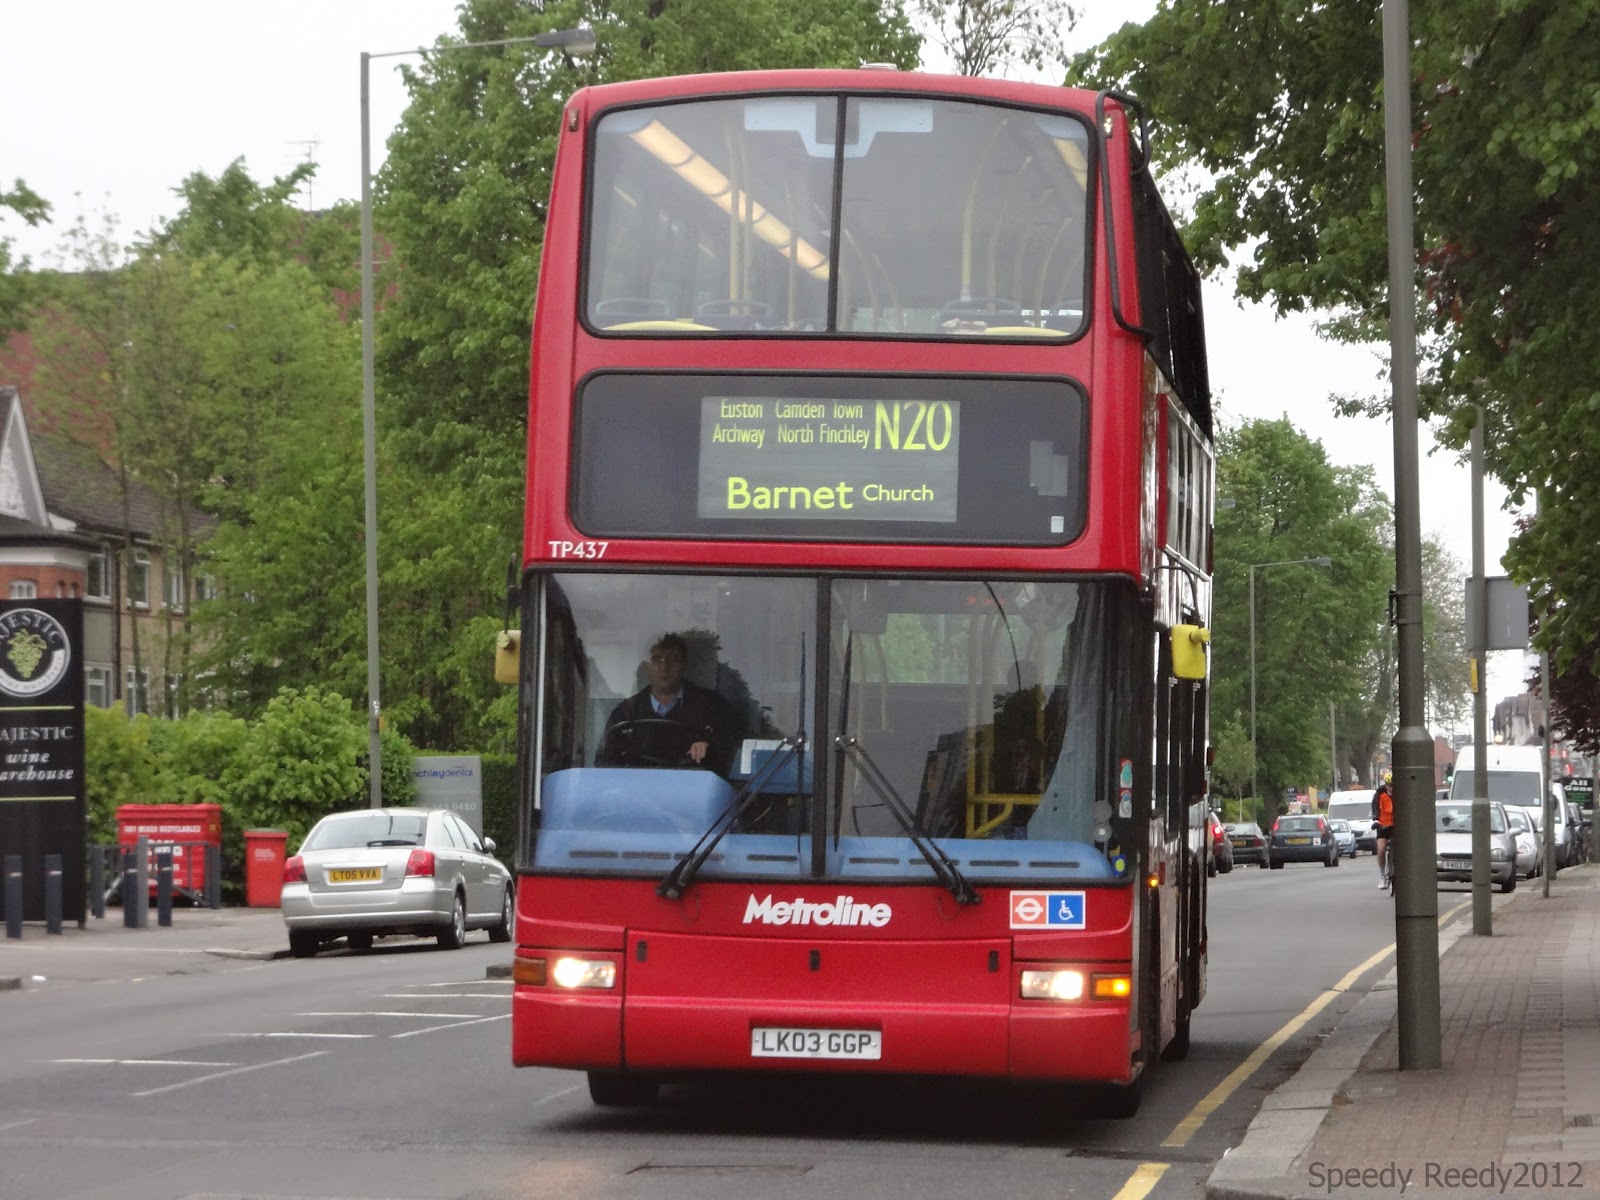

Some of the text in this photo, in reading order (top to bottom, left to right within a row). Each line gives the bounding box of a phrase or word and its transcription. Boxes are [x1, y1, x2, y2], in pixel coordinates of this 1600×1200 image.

[720, 400, 863, 419] Euston Camden Town
[874, 400, 952, 451] N20
[712, 424, 869, 449] Archway North Finchley
[727, 477, 934, 509] Barnet Church
[548, 541, 608, 558] TP437
[0, 726, 73, 743] AJESTIC
[6, 748, 50, 763] wine
[0, 765, 74, 781] arehouse
[333, 869, 377, 880] LT05 VVA
[743, 894, 892, 927] Metroline
[762, 1031, 872, 1054] LK03 GGP
